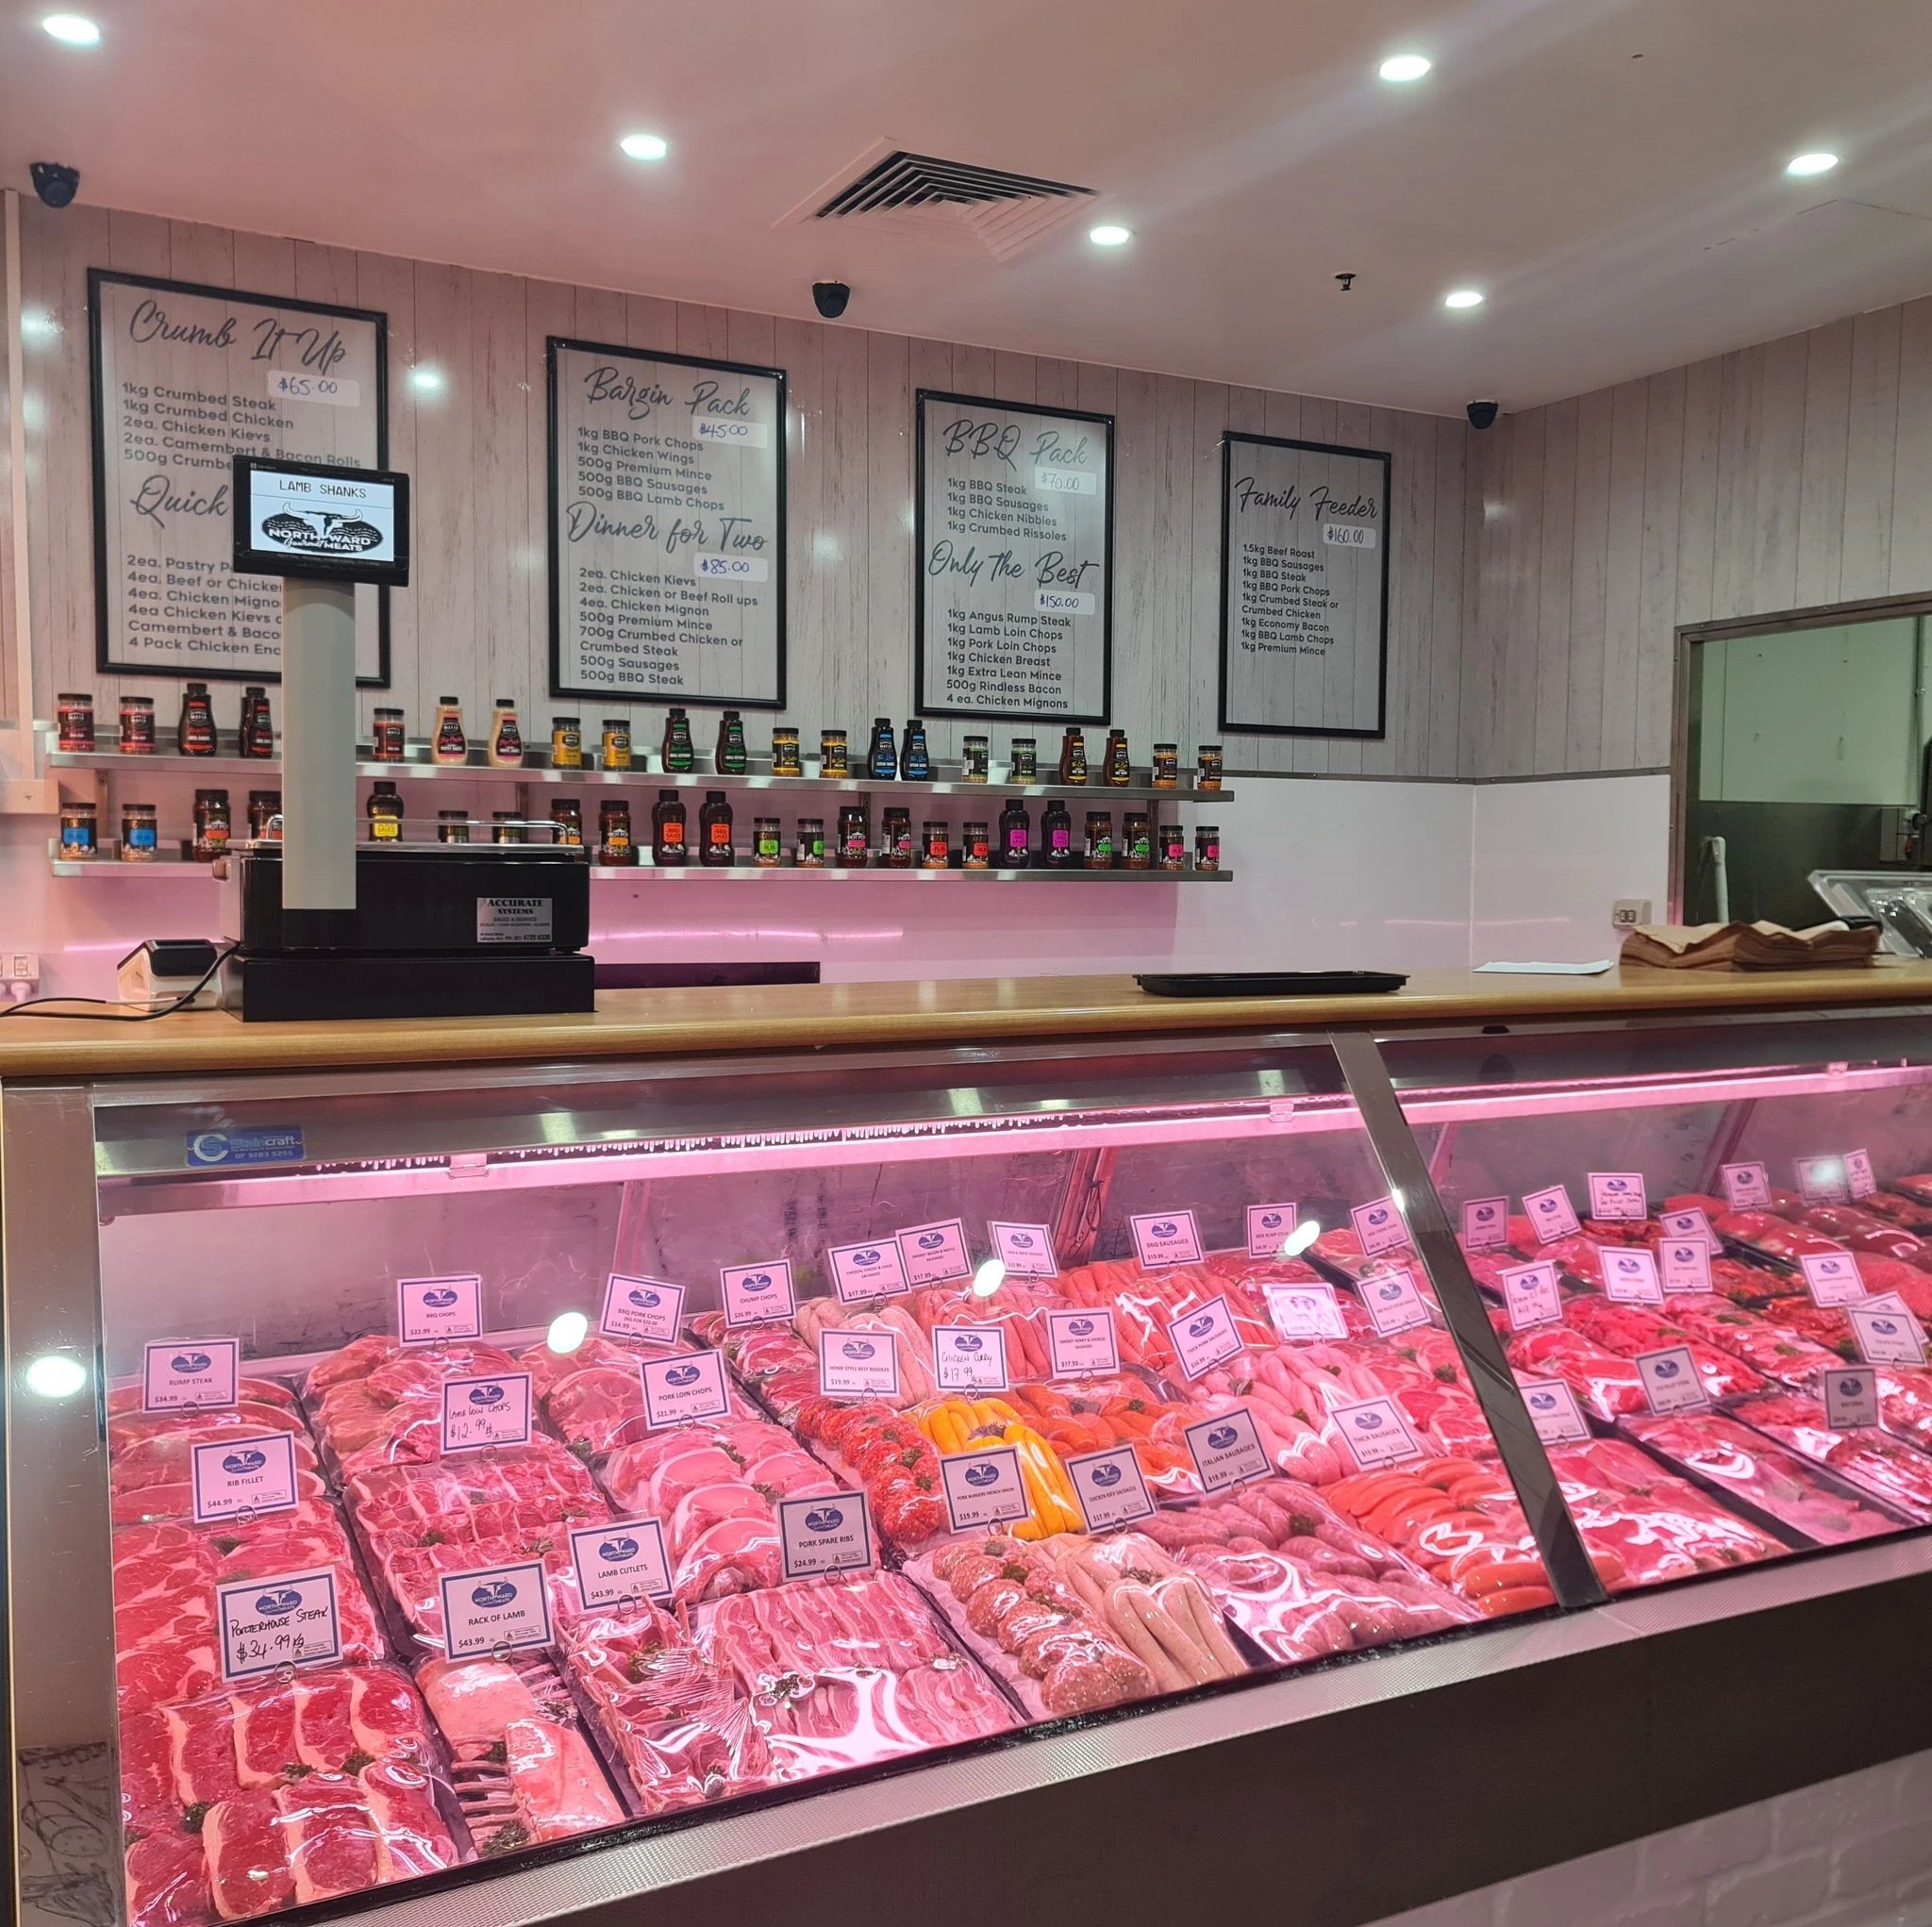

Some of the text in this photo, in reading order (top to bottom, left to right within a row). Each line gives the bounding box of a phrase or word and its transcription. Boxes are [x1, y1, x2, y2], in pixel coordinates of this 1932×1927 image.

[130, 300, 346, 375] Crumb It Up
[278, 376, 338, 396] $65.00
[584, 367, 750, 420] Bargin Pack
[123, 382, 276, 410] 1kg Crumbed Steak
[123, 399, 293, 428] 1kg Crumbed Chicken
[124, 416, 271, 441] 2ea. Chicken Kievs
[577, 426, 704, 452] 1kg BBQ Pork Chops
[943, 420, 1088, 472] BBQ Pack
[124, 433, 361, 468] 2ea. Camembert & Bacon Rolls
[578, 457, 711, 480] 500g Premium Mince
[279, 479, 366, 498] LAMB SHANKS
[948, 478, 1027, 495] 1kg BBQ Steak
[1041, 473, 1079, 490] $70.00
[130, 474, 228, 528] Quick
[1235, 477, 1377, 521] Family Feeder
[948, 507, 1058, 526] 1kg Chicken Nibbles
[566, 502, 768, 554] Dinner for Two
[1327, 528, 1363, 543] $160.00
[269, 529, 371, 545] NORTH WARD
[325, 542, 362, 552] MEATS
[1243, 544, 1315, 558] 1.5kg Beef Roast
[701, 558, 749, 574] $85.00
[928, 540, 984, 587] Only
[1035, 552, 1100, 589] Best
[579, 583, 608, 593] 2ea.
[610, 585, 660, 598] Chicken
[680, 590, 708, 601] Beef
[711, 594, 733, 604] Roll
[737, 597, 758, 606] ups
[1041, 594, 1079, 607] $150.00
[1242, 593, 1257, 603] 1kg
[1259, 595, 1300, 606] Crumbed
[1303, 598, 1327, 607] Steak
[128, 604, 271, 624] 4ea Chicken Kievs
[580, 598, 709, 617] 4ea. Chicken Mignon
[1241, 606, 1321, 619] Crumbed Chicken
[948, 609, 1071, 627] 1kg Angus Rump Steak
[1241, 619, 1329, 632] 1kg Economy Bacon
[579, 626, 613, 640] 700g
[618, 629, 675, 642] Crumbed
[679, 634, 727, 645] Chicken
[128, 638, 249, 654] 4 Pack Chicken
[580, 641, 678, 656] Crumbed Steak
[581, 656, 679, 672] 500g Sausages
[947, 652, 1050, 666] 1kg Chicken Breast
[947, 666, 1061, 681] 1kg Extra Lean Mince
[947, 680, 1061, 694] 500g Rindless Bacon
[657, 1409, 676, 1418] $21.99
[1203, 1444, 1255, 1467] ITALIAN SAUSAGES
[242, 1476, 263, 1485] FILLET
[208, 1499, 232, 1508] $44.99
[598, 1564, 648, 1578] LAMB CUTLETS
[794, 1559, 816, 1568] $24.99
[591, 1589, 614, 1599] $43.99
[296, 1606, 328, 1622] STEAK
[468, 1617, 490, 1626] RACK
[503, 1610, 525, 1620] LAMB
[237, 1635, 290, 1664] $34.99
[458, 1637, 485, 1648] $43.99
